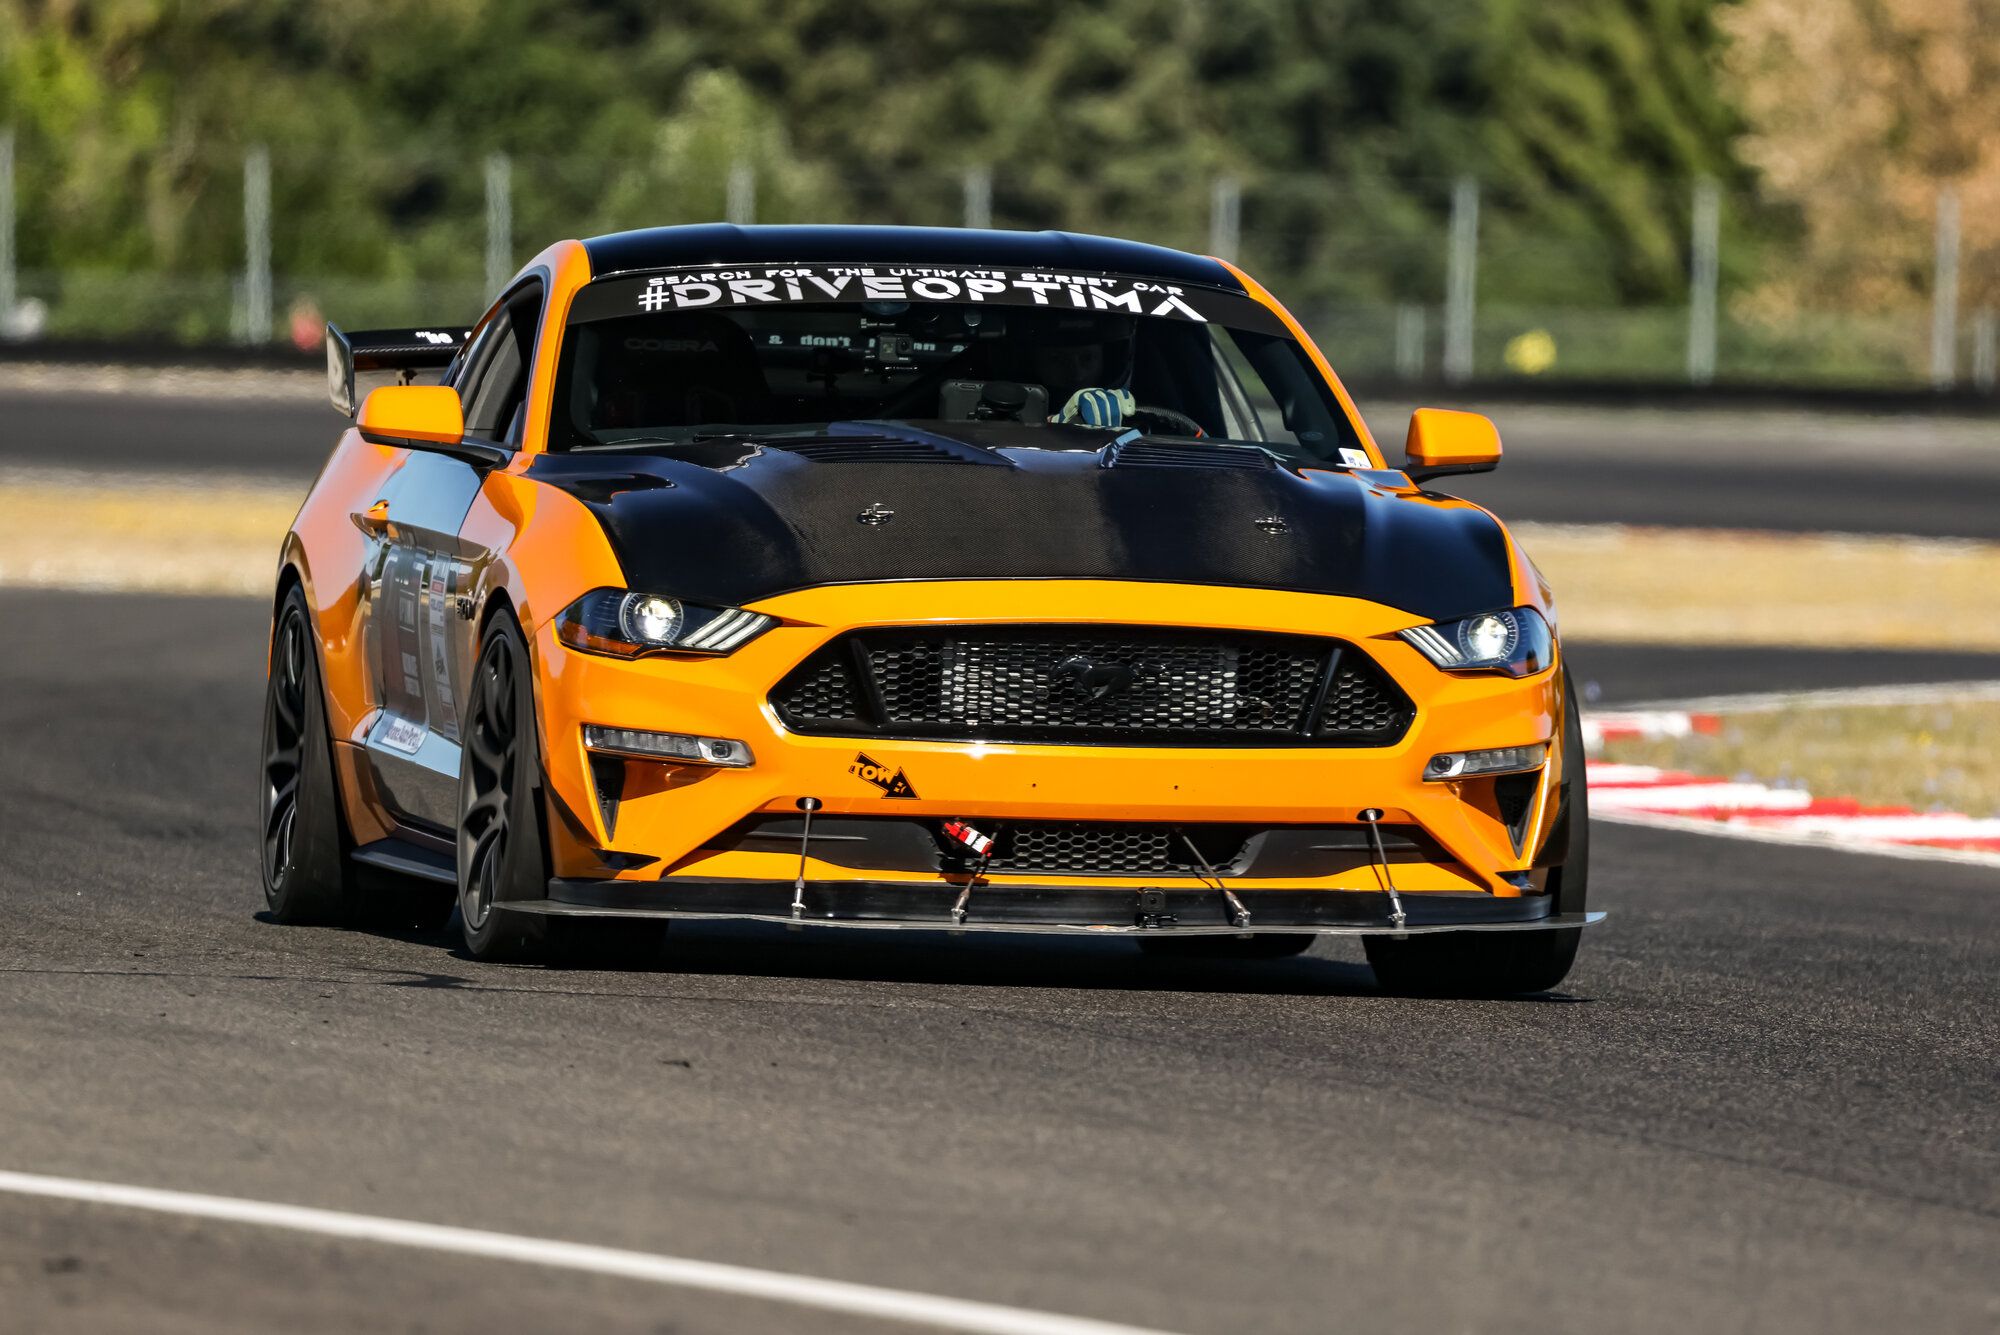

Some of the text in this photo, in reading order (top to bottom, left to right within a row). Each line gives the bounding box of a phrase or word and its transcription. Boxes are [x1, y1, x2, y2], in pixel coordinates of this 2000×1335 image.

[648, 268, 1185, 296] SEARCH FOR THE ULTIMATE STREET CAR
[637, 276, 1208, 322] #DRIVEOPTIMA
[624, 338, 719, 352] COBRA
[849, 761, 897, 784] TOW
